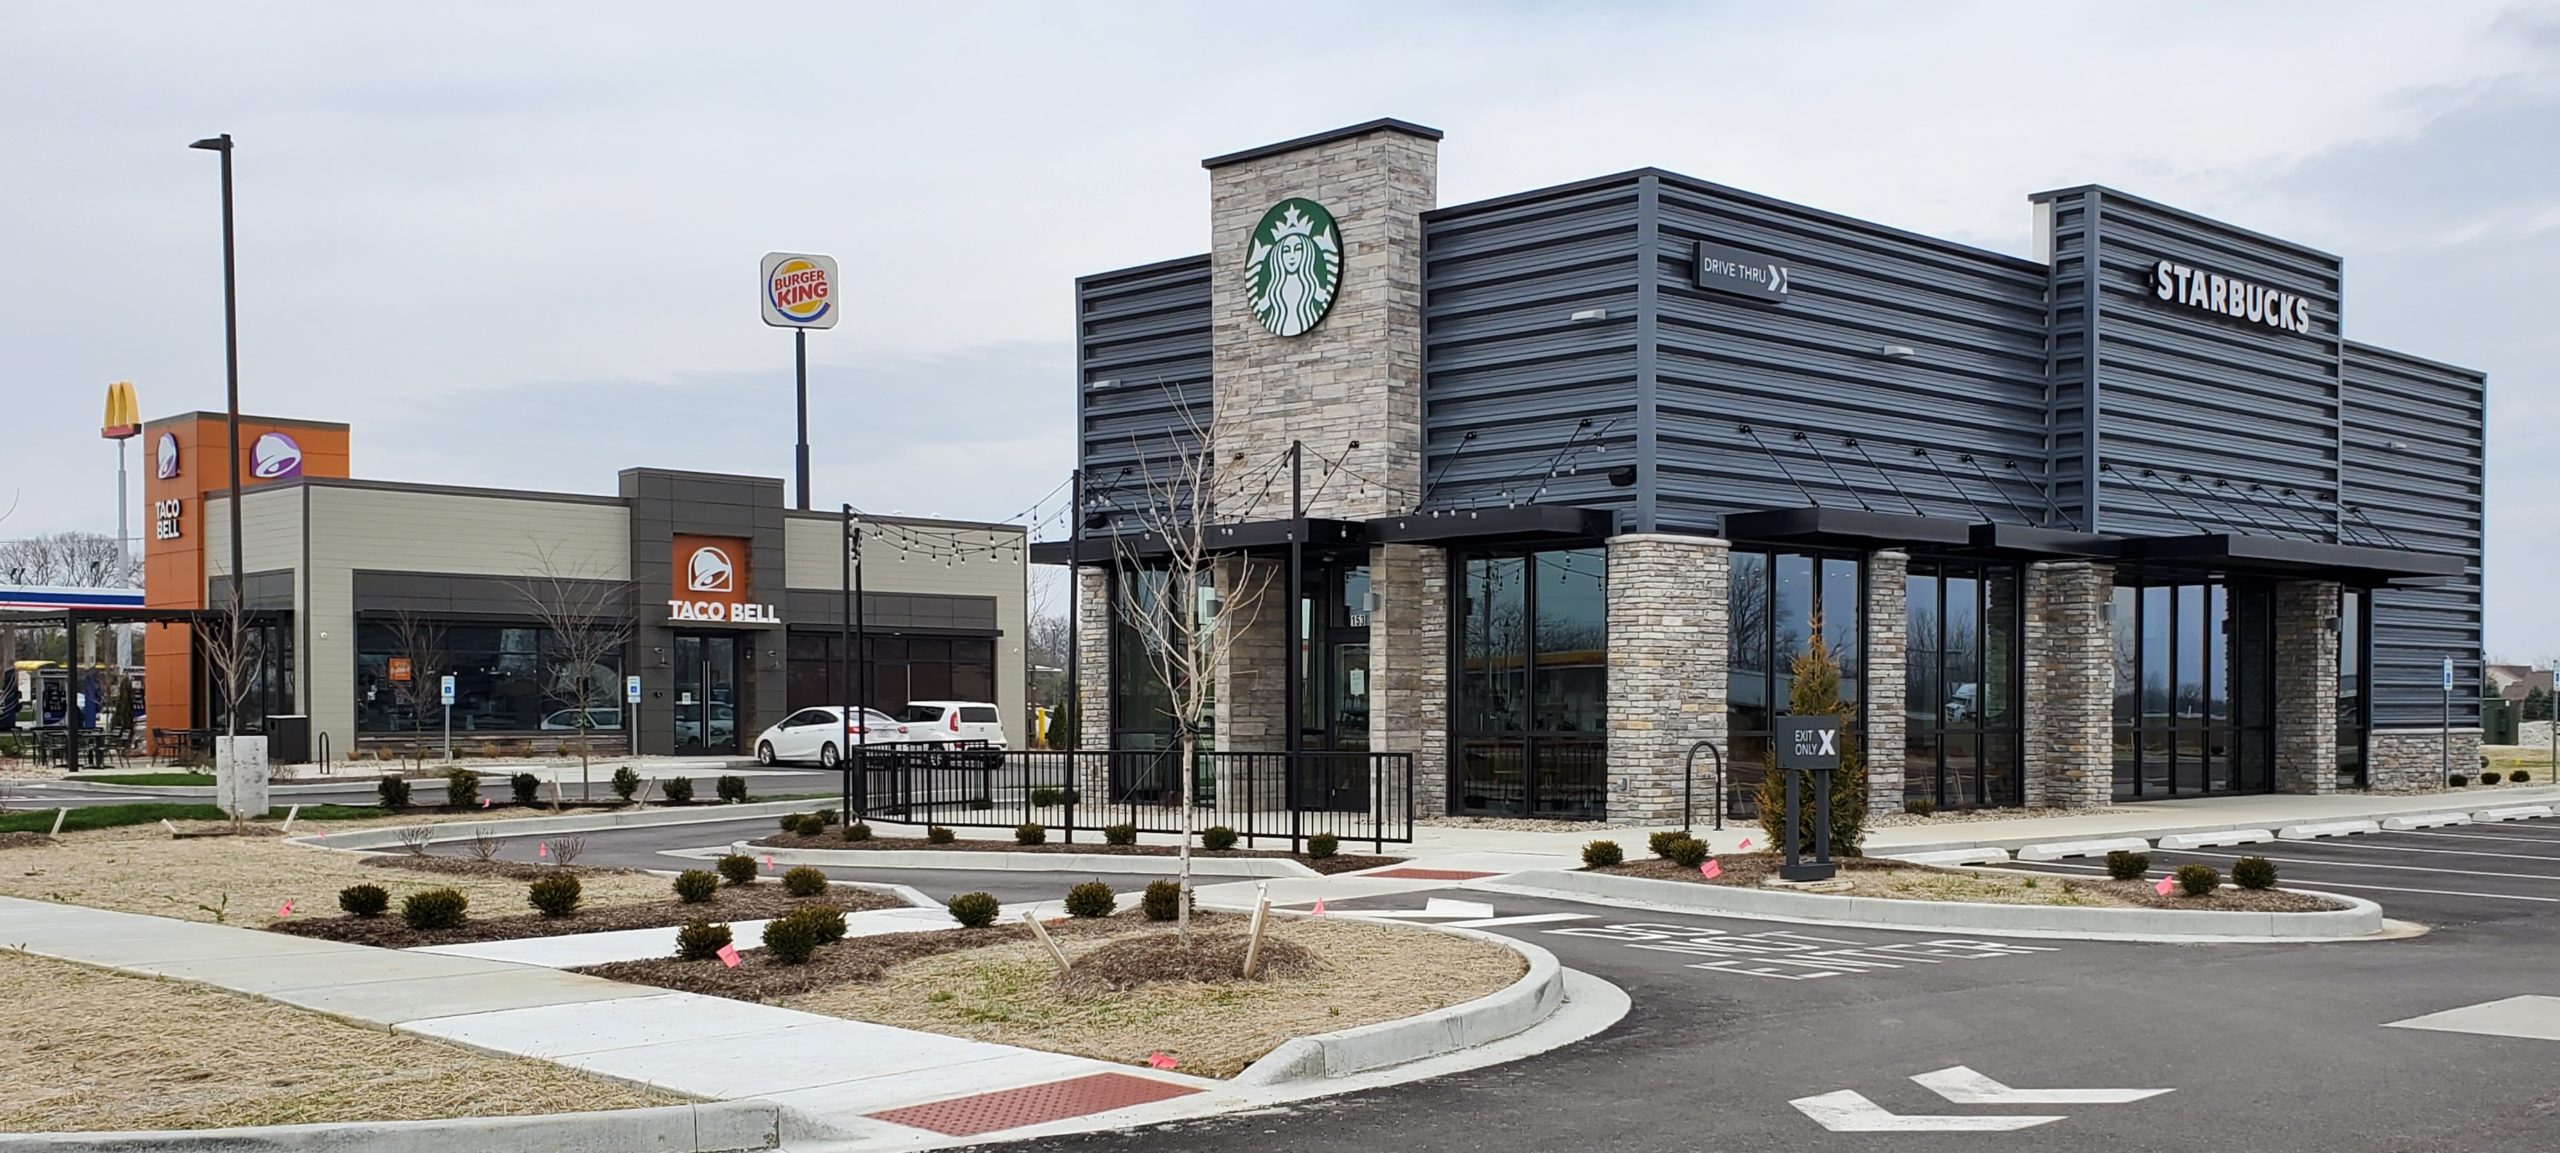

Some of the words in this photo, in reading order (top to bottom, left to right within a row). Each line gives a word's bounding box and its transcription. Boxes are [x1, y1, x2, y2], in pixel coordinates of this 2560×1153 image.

[774, 269, 825, 292] BURGER
[1704, 257, 1736, 277] DRIVE
[1738, 264, 1766, 284] THRU
[777, 281, 828, 308] KING
[2157, 260, 2309, 334] STARBUCKS
[155, 499, 180, 519] TACO
[157, 519, 180, 540] BELL
[668, 600, 726, 621] TACO
[730, 603, 781, 624] BELL
[1795, 730, 1813, 742] EXIT
[1795, 743, 1818, 756] ONLY
[1539, 923, 1728, 941] DO
[1623, 931, 1867, 958] NOT
[1684, 940, 2061, 981] ENTER
